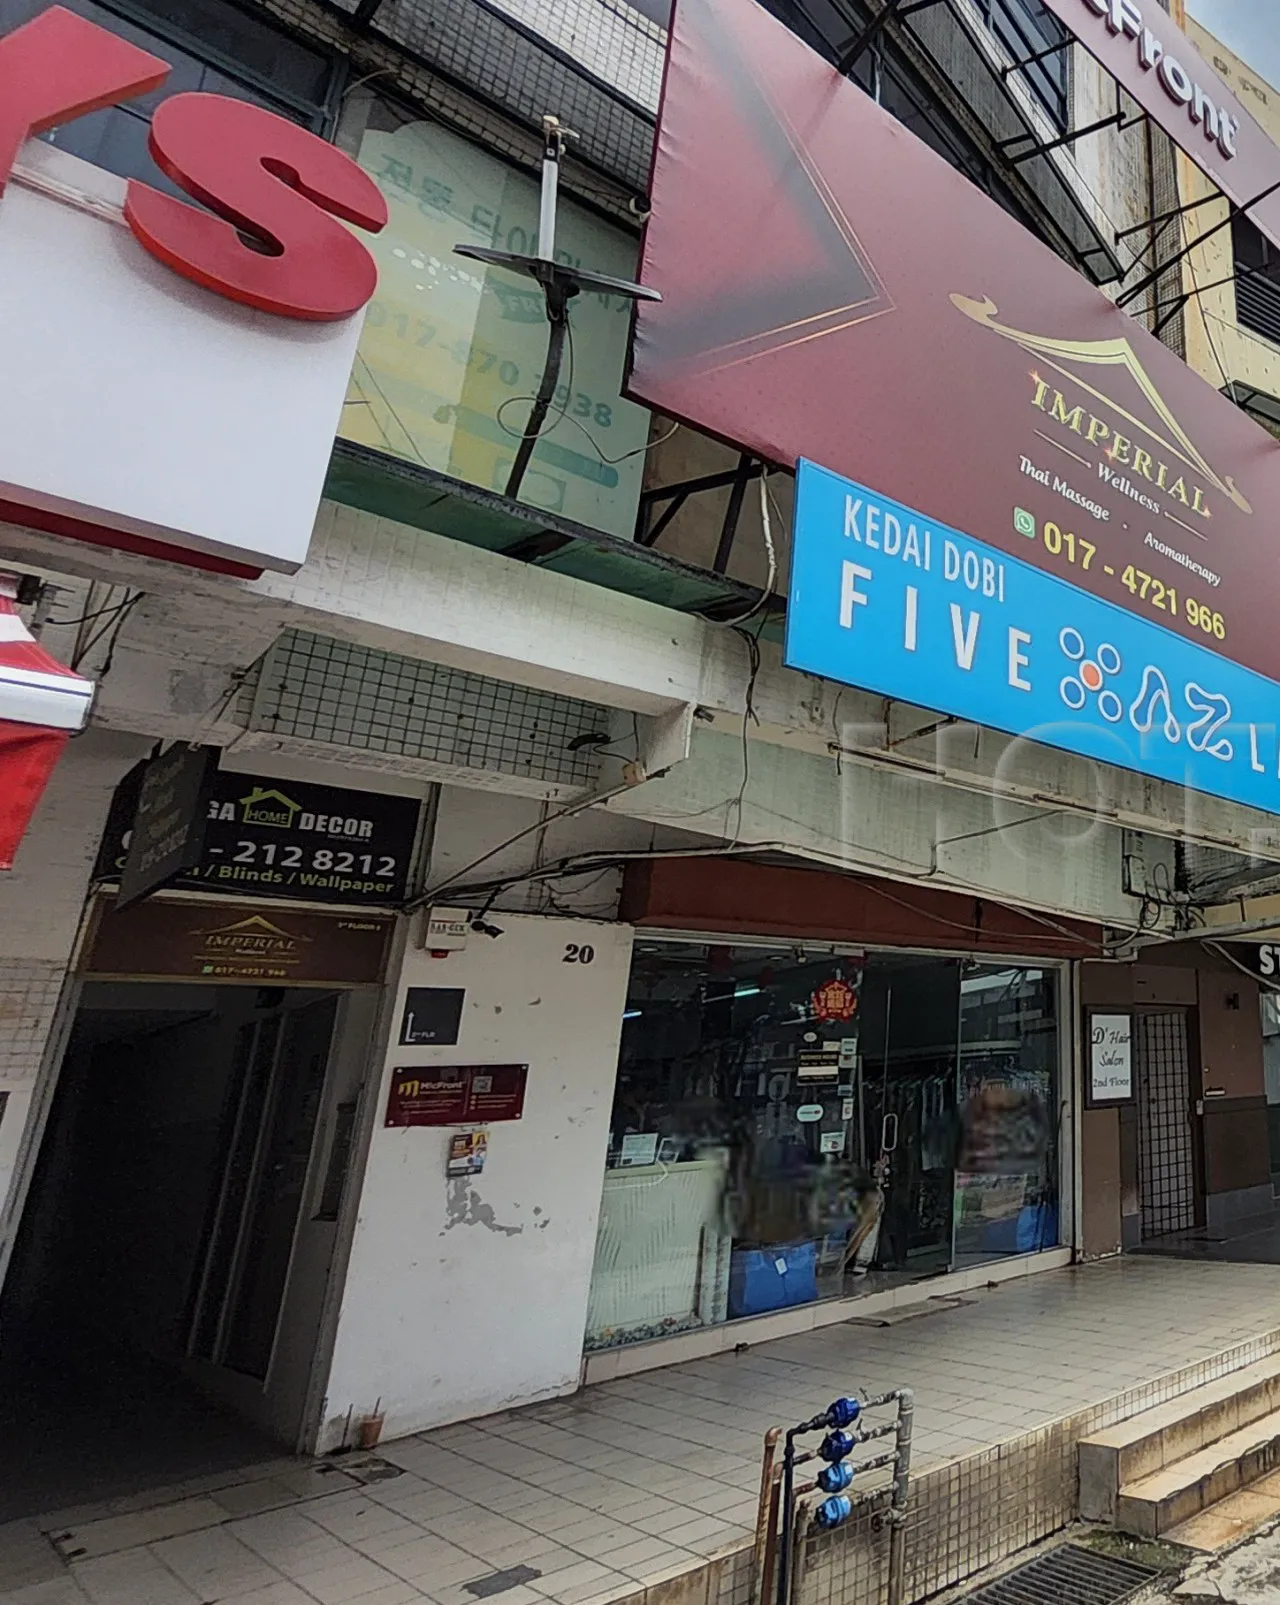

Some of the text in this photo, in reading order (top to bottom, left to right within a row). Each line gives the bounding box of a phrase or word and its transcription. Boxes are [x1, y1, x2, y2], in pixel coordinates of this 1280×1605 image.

[1031, 377, 1212, 518] IMPERIAL
[1098, 462, 1160, 514] Wellness
[1019, 455, 1221, 587] Thai Massage Aromatherapy
[844, 495, 1004, 602] KEDAI DOBI
[1044, 521, 1097, 570] 017
[1121, 565, 1178, 616] 4721
[1185, 597, 1226, 640] 966
[839, 559, 1032, 691] FIVE
[248, 808, 290, 825] HOME
[298, 813, 374, 838] DECOR
[232, 841, 303, 868] 212
[312, 850, 396, 877] 8212
[218, 866, 284, 885] Blinds
[299, 872, 396, 893] Wallpaper
[205, 935, 296, 950] IMPERIAL
[562, 943, 595, 964] 20
[1109, 1031, 1132, 1044] Hair
[1099, 1050, 1124, 1067] Salon
[1093, 1077, 1130, 1088] 2nd Floor
